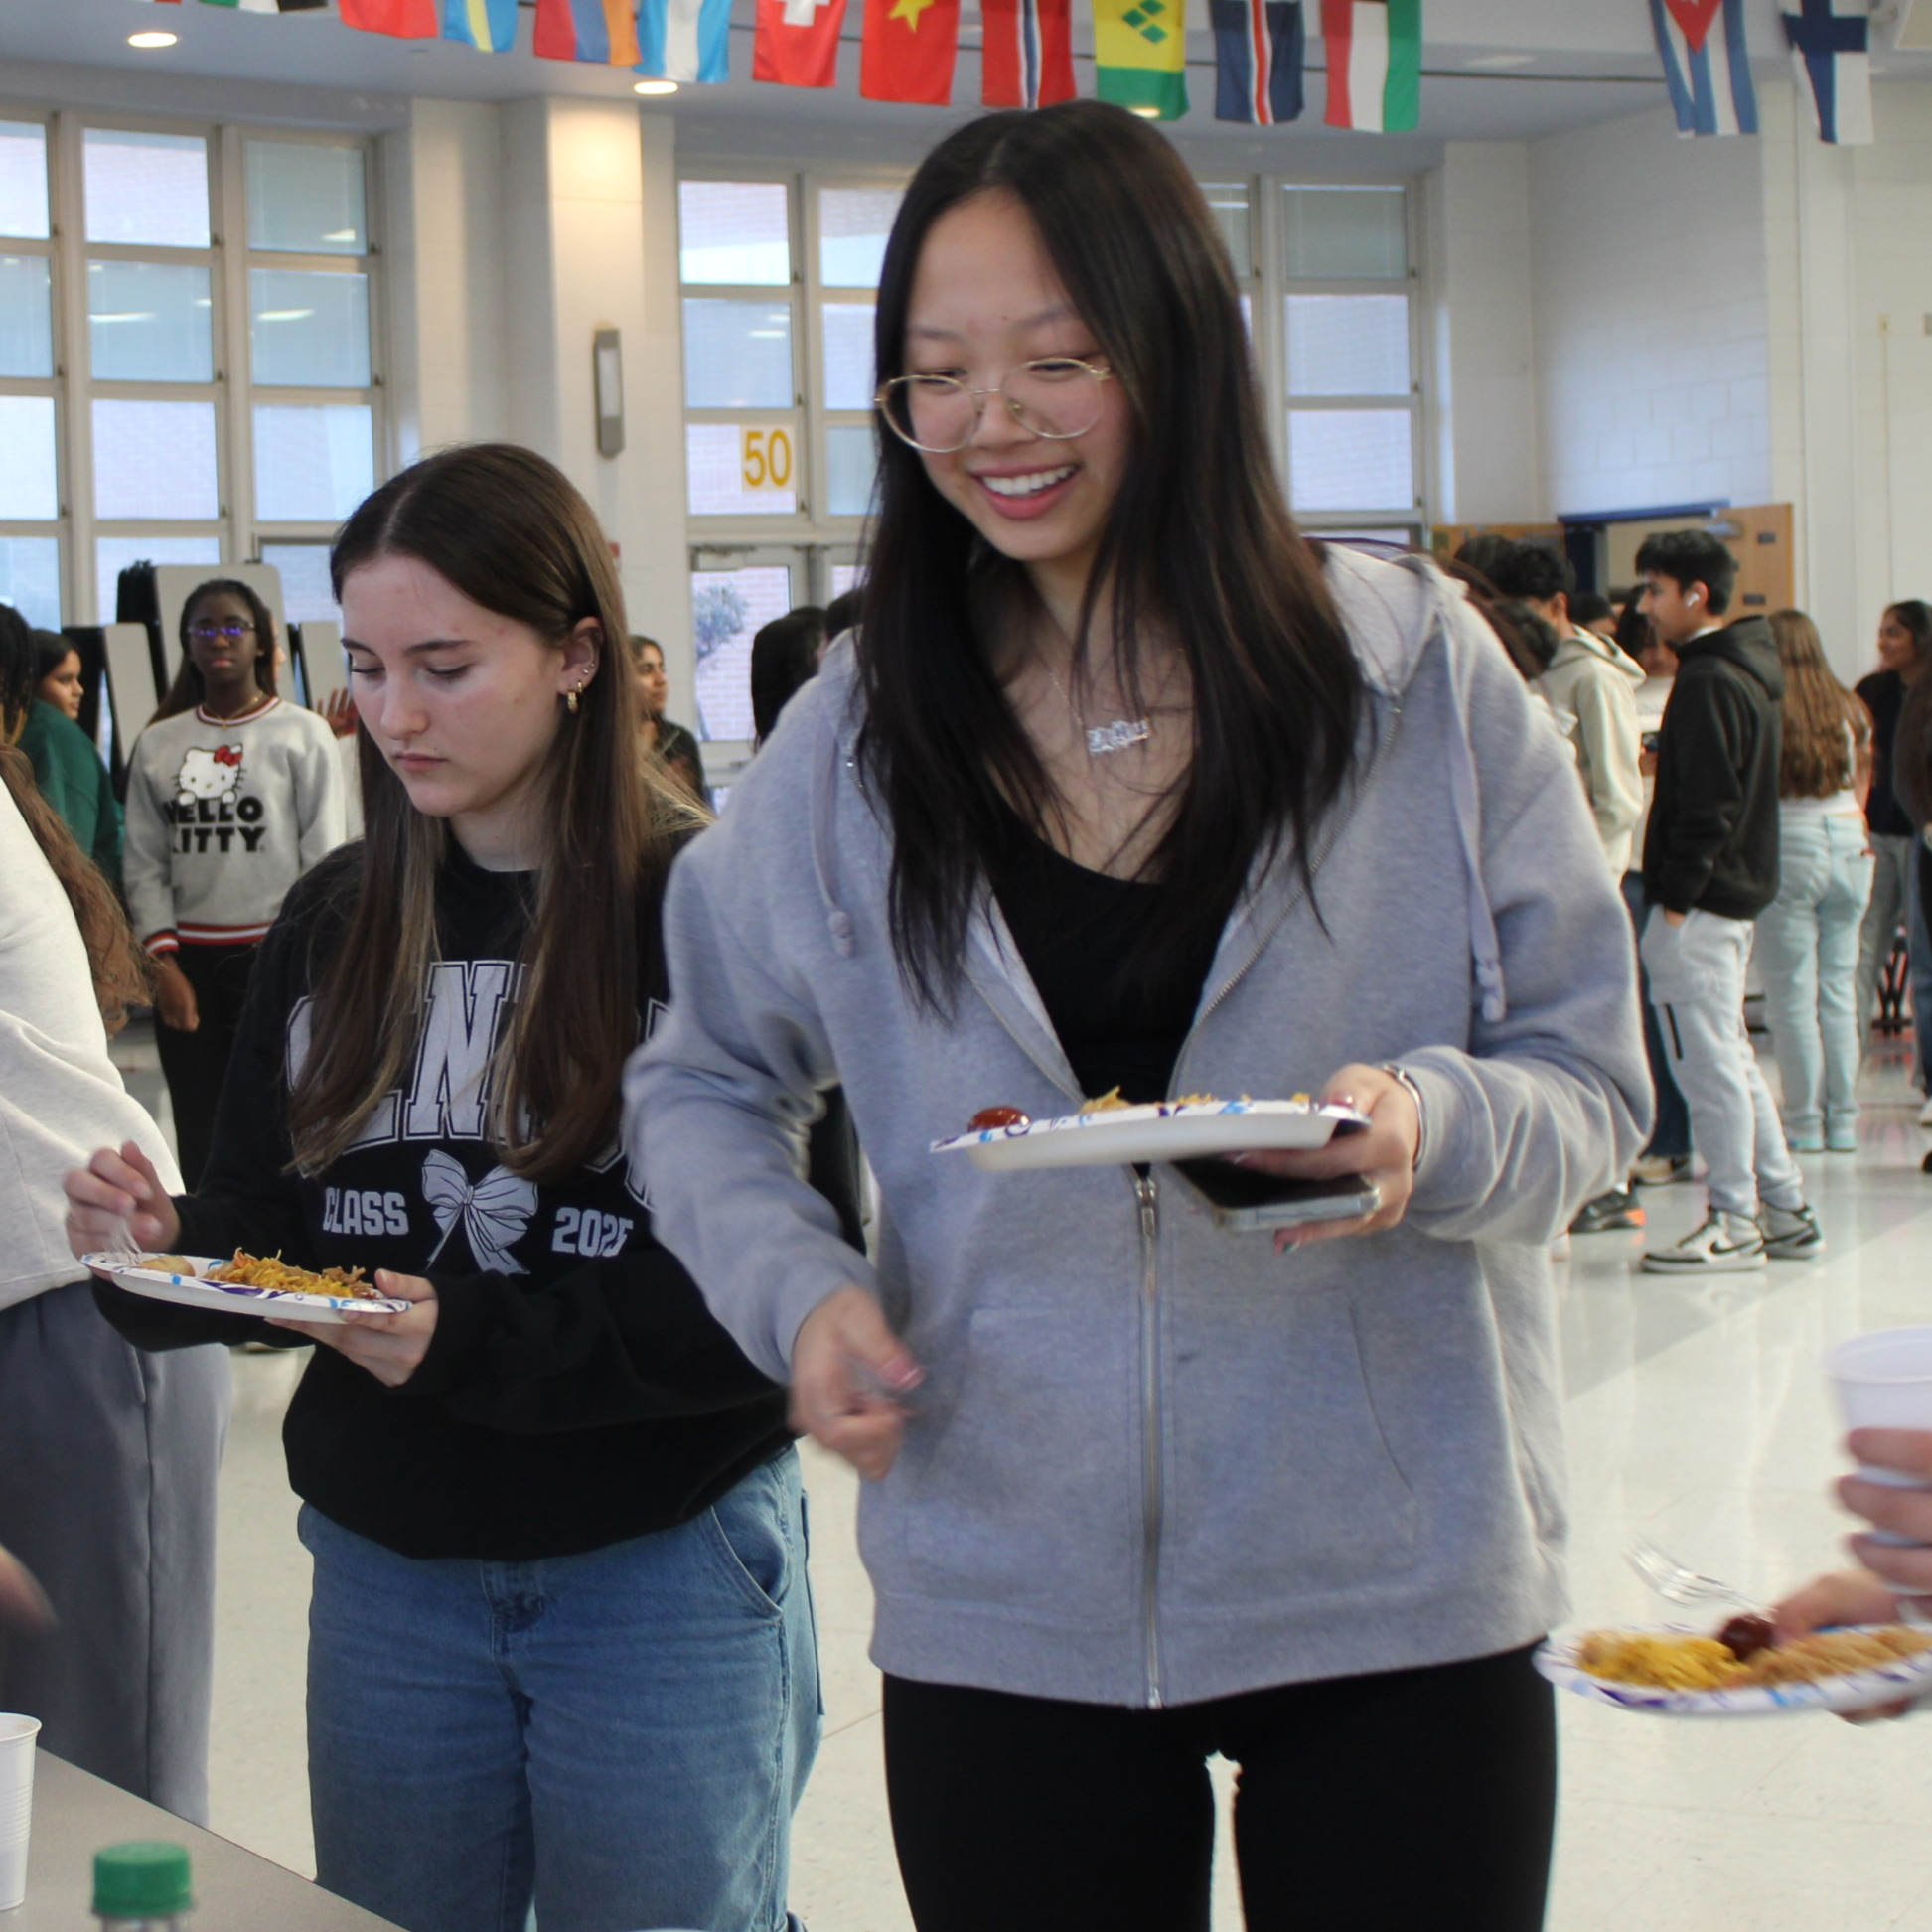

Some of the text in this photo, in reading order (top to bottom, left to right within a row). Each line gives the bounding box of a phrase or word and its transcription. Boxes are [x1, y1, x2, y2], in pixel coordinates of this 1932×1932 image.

[744, 429, 792, 488] 50
[173, 826, 266, 853] ITTY
[323, 1186, 634, 1258] CLASS 2025
